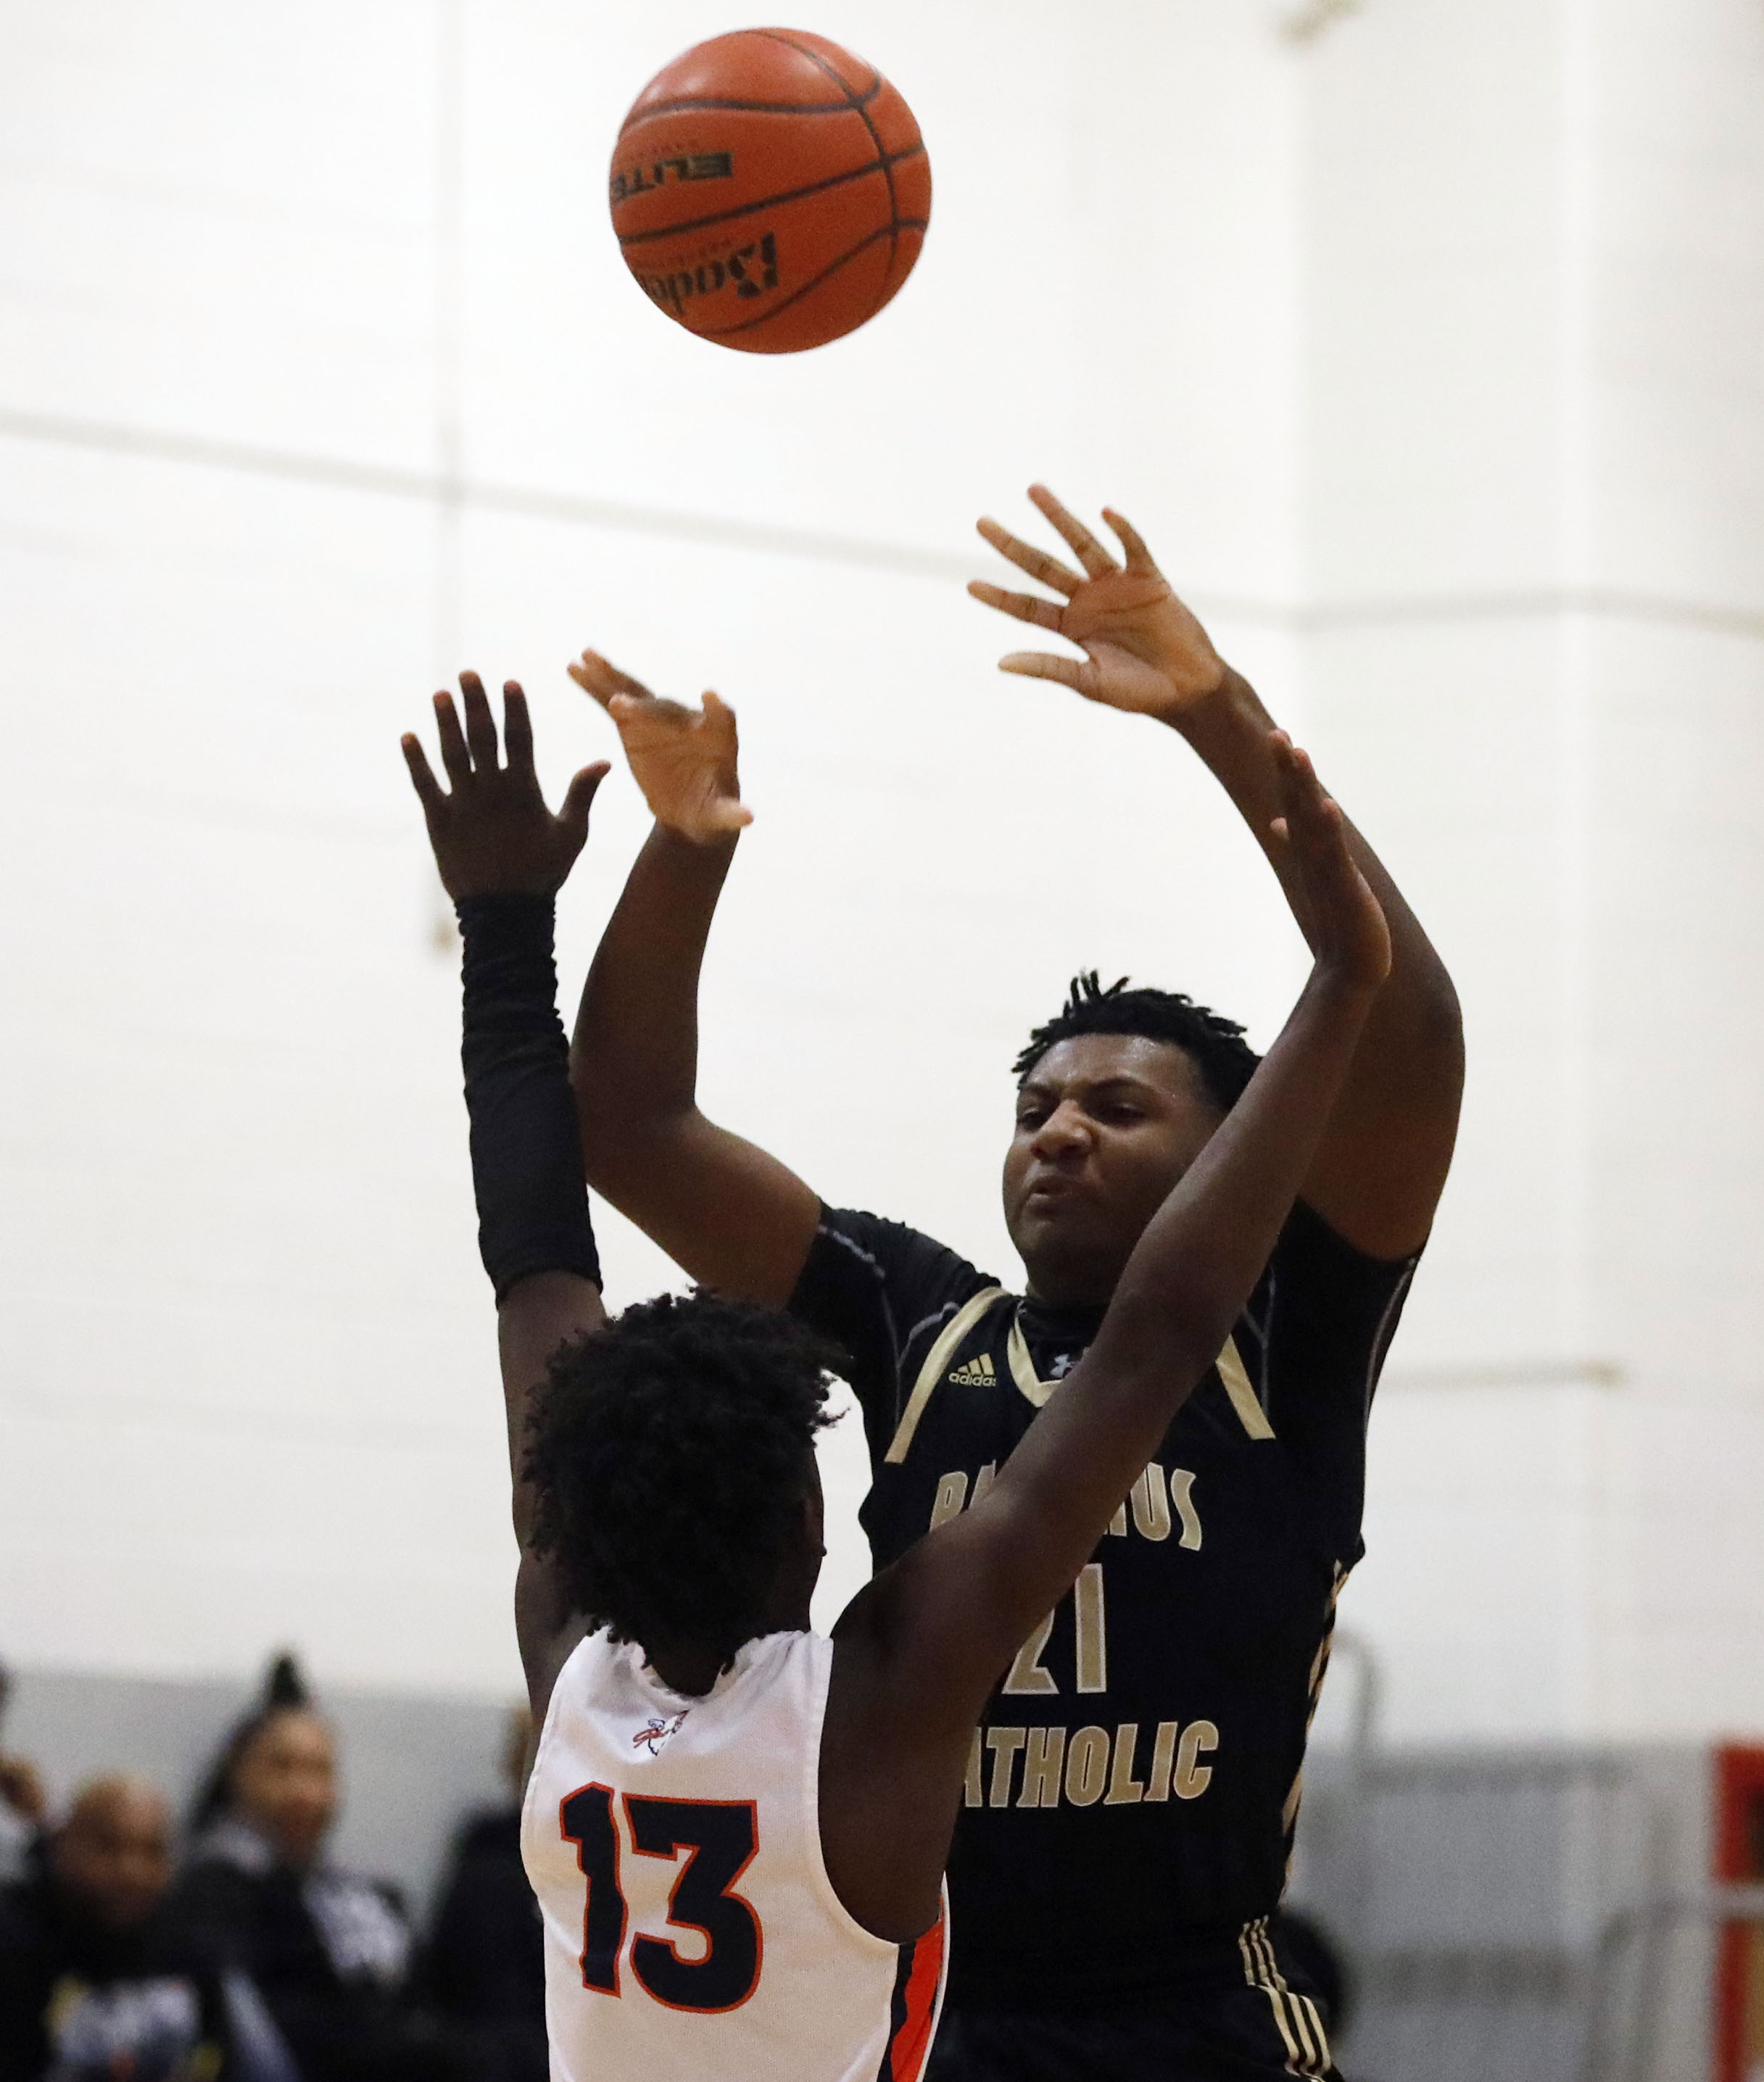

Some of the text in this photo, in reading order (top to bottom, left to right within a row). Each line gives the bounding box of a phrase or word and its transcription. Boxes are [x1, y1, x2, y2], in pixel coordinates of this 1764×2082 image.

[613, 151, 733, 204] ELITE
[948, 1372, 997, 1388] adidas
[964, 1720, 1220, 1808] ATHOLIC
[559, 1781, 763, 2015] 13
